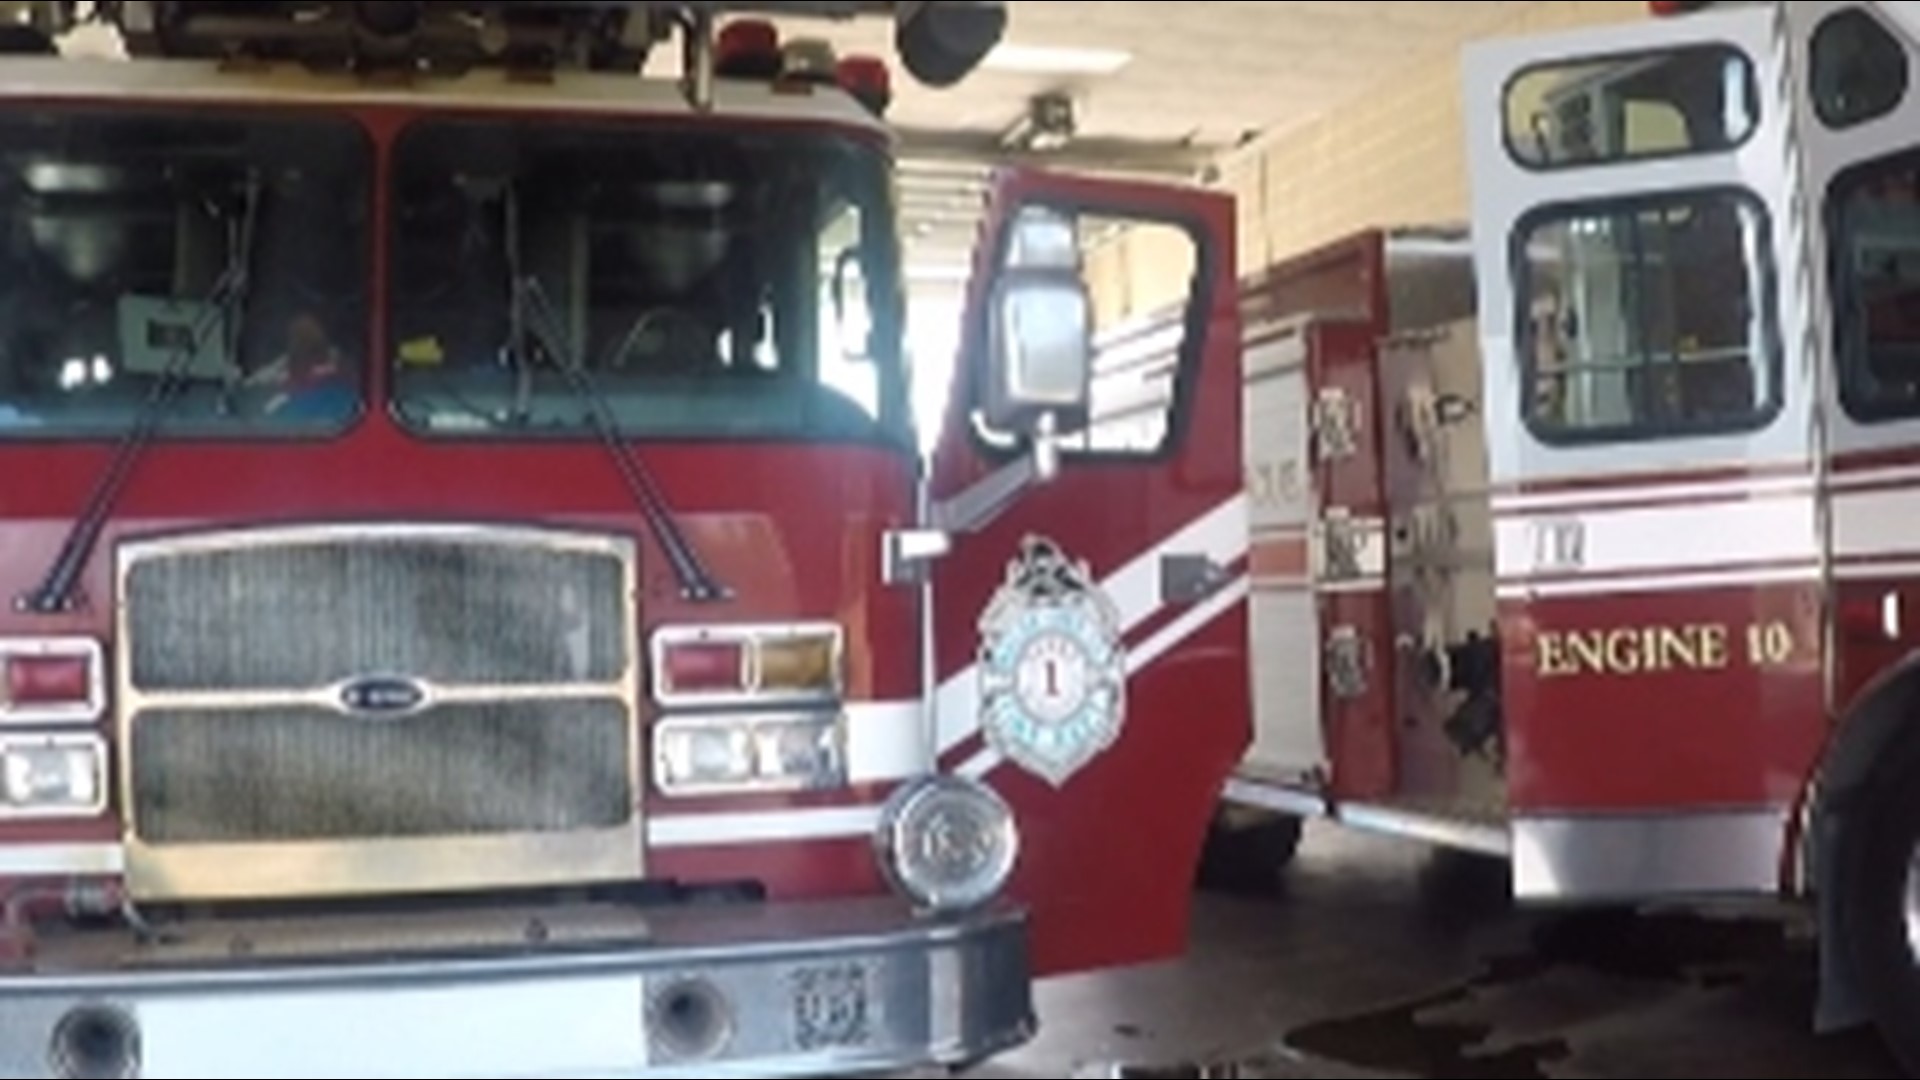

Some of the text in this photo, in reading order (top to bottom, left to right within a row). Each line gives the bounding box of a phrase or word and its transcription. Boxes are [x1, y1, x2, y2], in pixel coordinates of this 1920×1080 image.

[1535, 621, 1794, 678] ENGINE 10
[1044, 659, 1062, 698] 1
